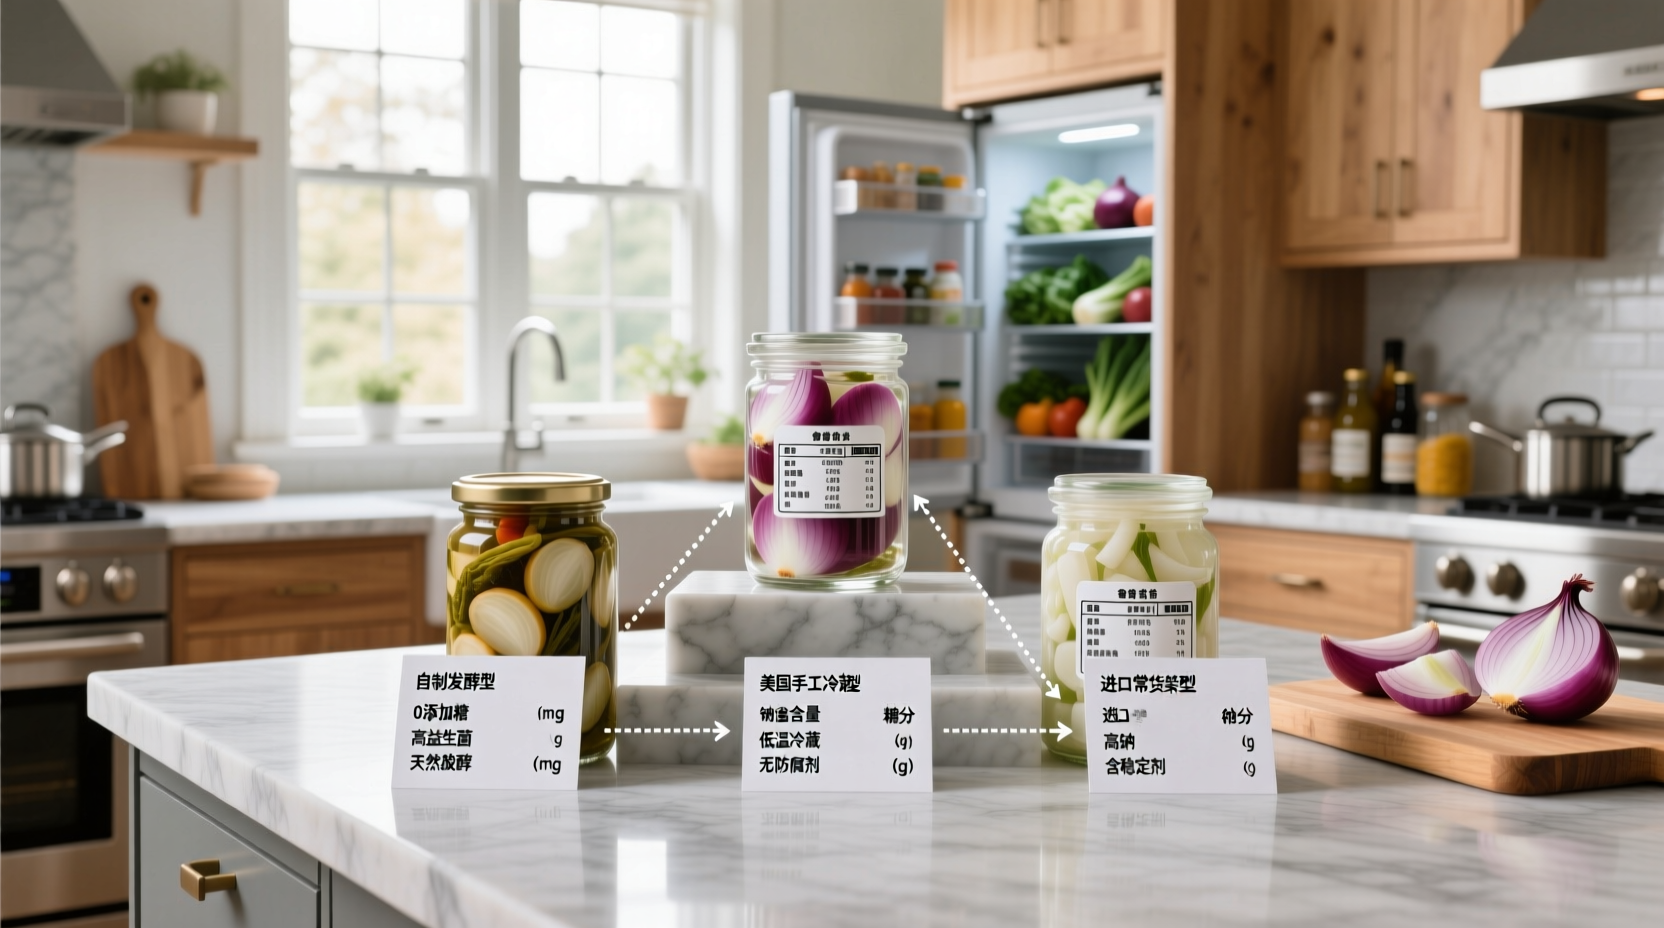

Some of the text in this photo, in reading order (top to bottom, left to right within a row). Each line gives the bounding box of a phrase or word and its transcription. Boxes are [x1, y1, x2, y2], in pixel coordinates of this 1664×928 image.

[416, 672, 496, 691] 自制发酵型
[413, 703, 565, 723] 0添加糖 (mg
[411, 729, 473, 747] 高益生菌
[759, 731, 913, 750] 低温冷藏 (g)
[533, 755, 562, 775] (mg
[892, 758, 914, 776] (g)
